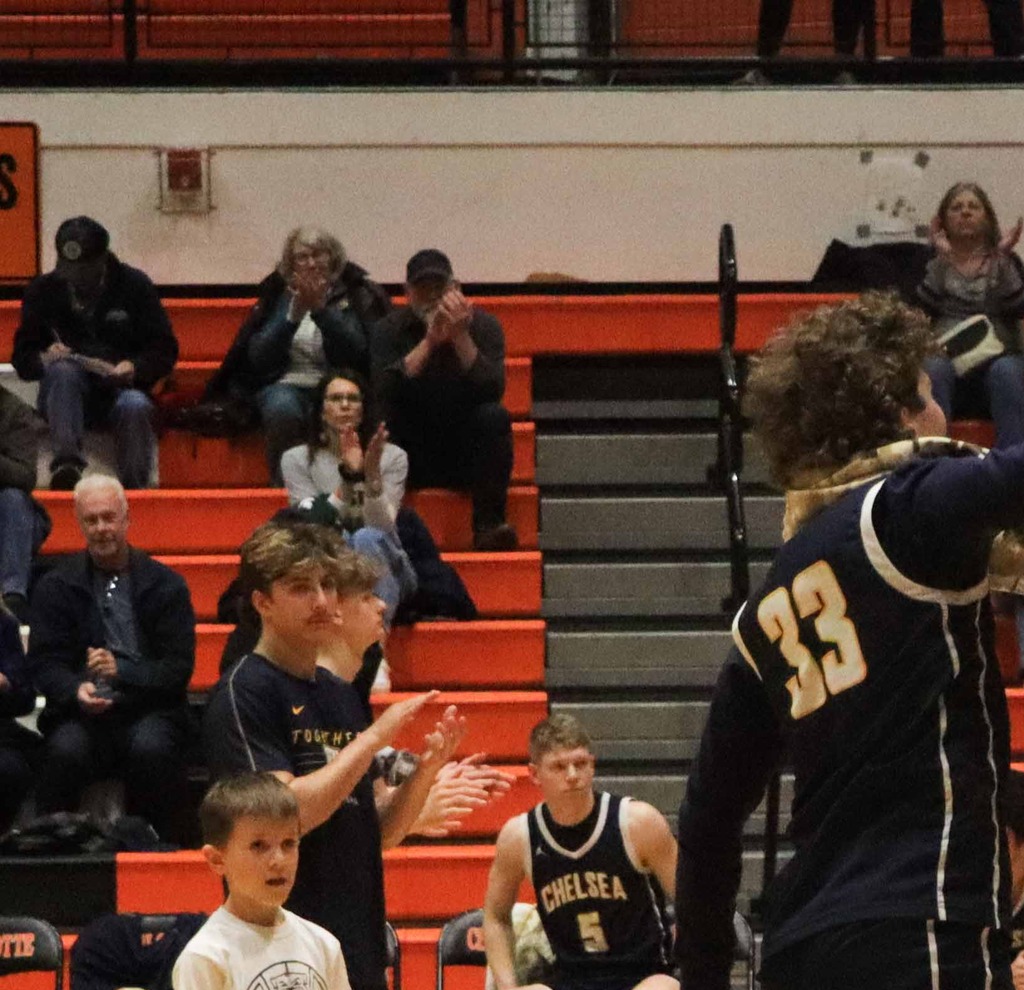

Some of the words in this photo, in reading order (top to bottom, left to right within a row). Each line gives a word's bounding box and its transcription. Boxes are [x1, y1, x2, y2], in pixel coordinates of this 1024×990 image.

[757, 559, 868, 721] 33
[540, 870, 628, 913] CHELSEA
[577, 911, 610, 953] 5
